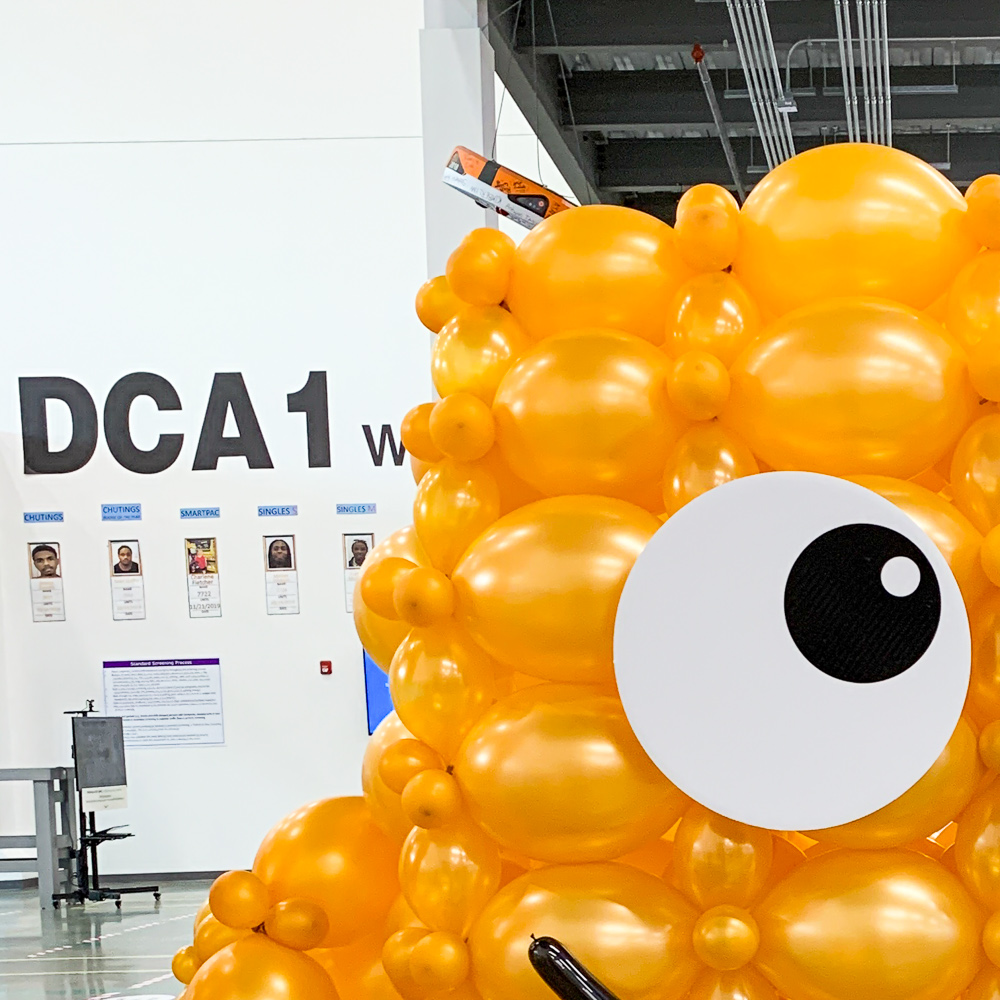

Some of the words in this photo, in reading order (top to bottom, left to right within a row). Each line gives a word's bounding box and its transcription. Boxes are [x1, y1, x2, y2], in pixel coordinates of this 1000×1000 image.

[18, 371, 331, 474] DCA1
[102, 505, 141, 514] CHUTINGS
[180, 508, 220, 518] SMARTPAC
[258, 507, 291, 516] SINGLES
[292, 506, 298, 515] S
[336, 505, 366, 514] SINGLES
[367, 504, 377, 513] M
[24, 513, 64, 522] CHUTINGS
